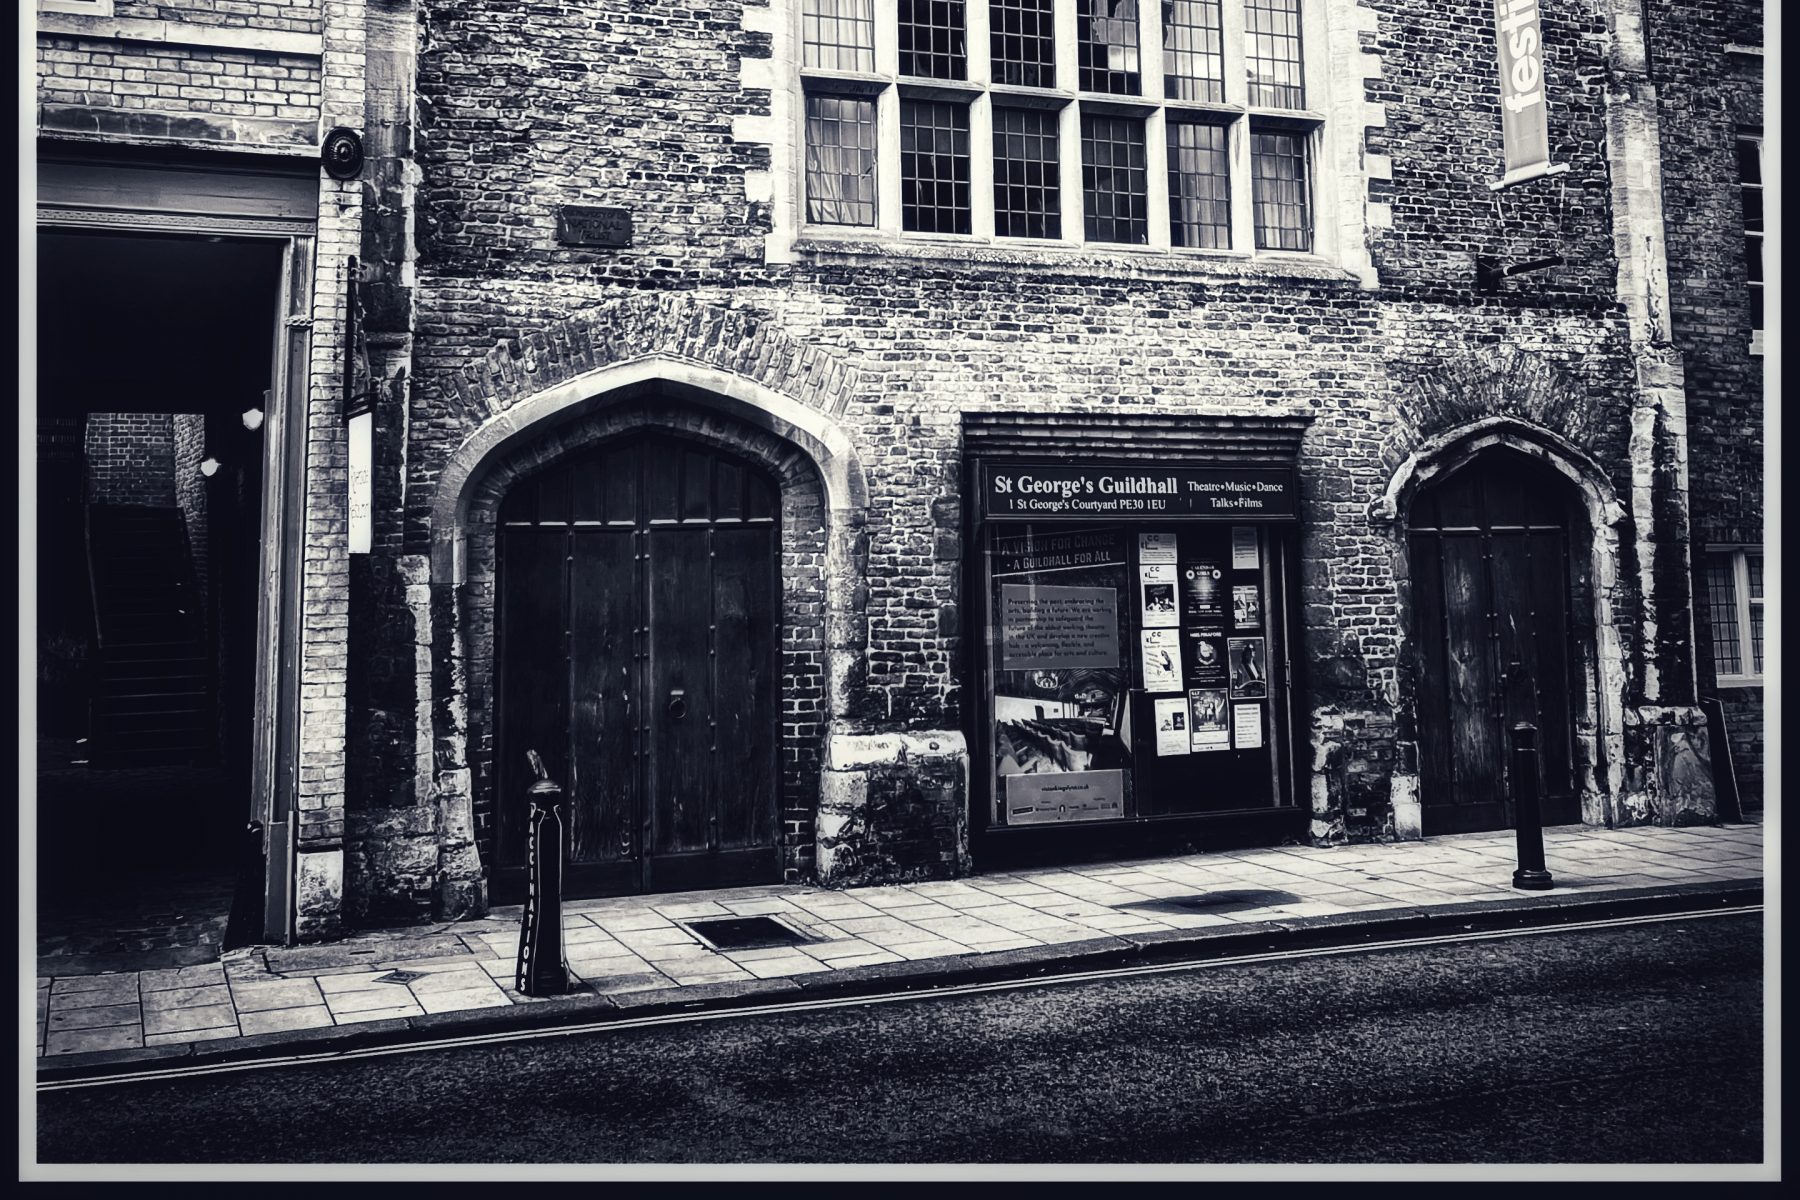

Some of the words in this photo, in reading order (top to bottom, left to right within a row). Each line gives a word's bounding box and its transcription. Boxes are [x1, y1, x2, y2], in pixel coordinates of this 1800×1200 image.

[995, 476, 1013, 493] St
[1017, 476, 1094, 497] George's
[1098, 477, 1178, 494] Guildhall
[1017, 499, 1027, 509] St
[1029, 499, 1070, 512] George's
[1071, 499, 1117, 512] Courtyard
[1120, 499, 1144, 510] PE30
[1147, 500, 1166, 510] 1EU
[1051, 537, 1071, 551] FOR
[1075, 533, 1115, 549] CHANGE
[1013, 559, 1020, 570] A
[1023, 554, 1072, 569] GUILDHALL
[1075, 552, 1092, 564] FOR
[1095, 550, 1111, 561] ALL
[520, 802, 536, 992] VACCINATIONS
